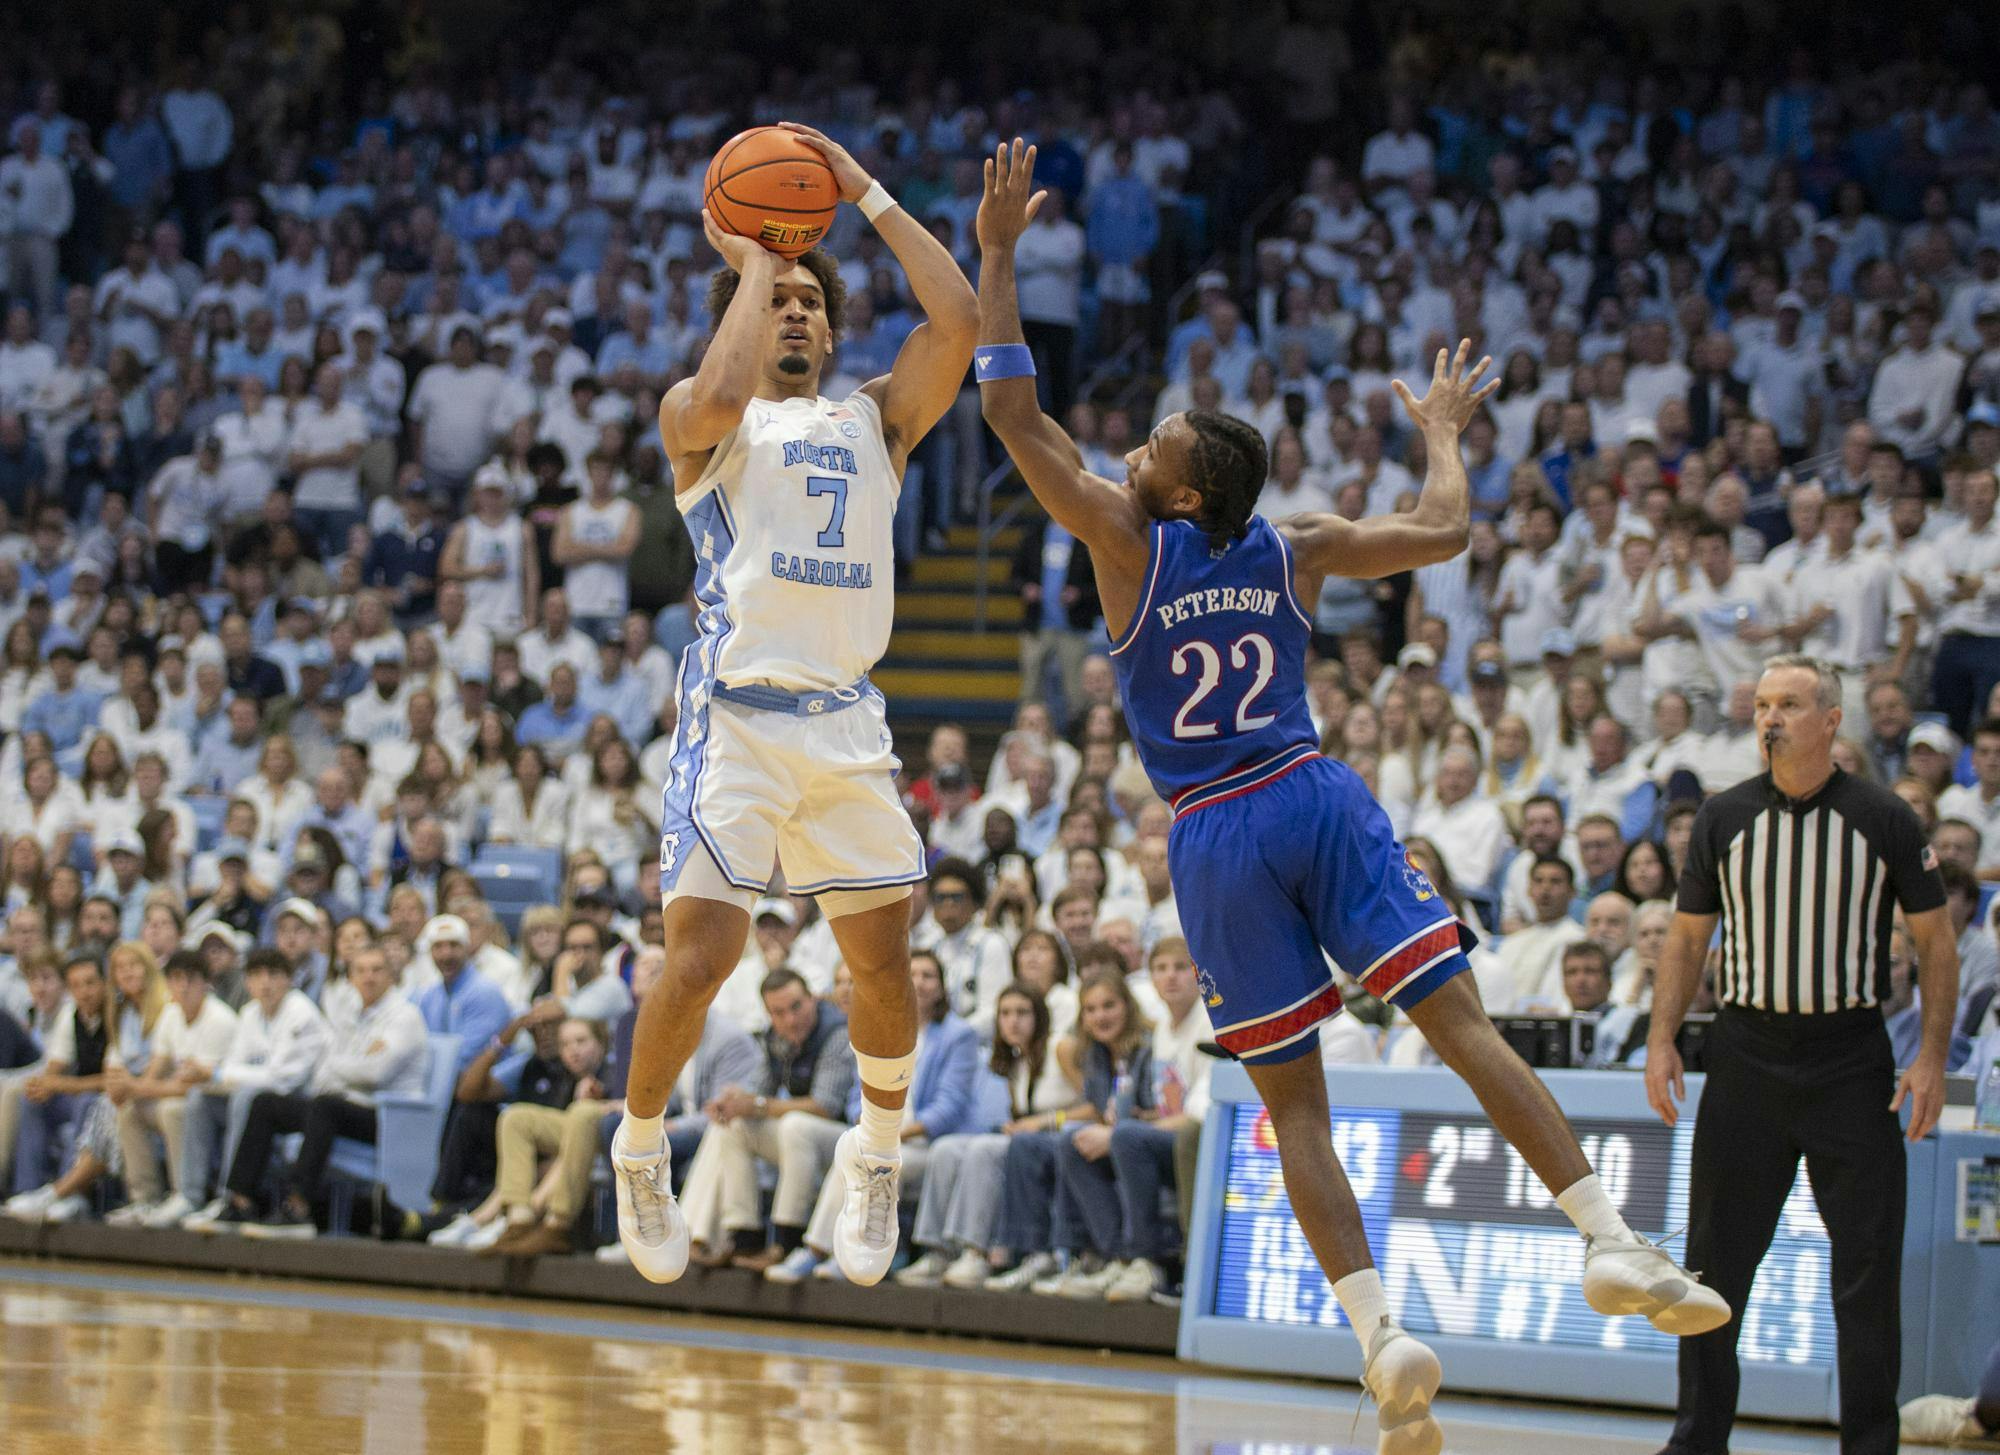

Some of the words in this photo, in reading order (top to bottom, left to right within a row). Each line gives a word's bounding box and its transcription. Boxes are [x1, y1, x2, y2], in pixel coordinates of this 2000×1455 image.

[760, 224, 824, 245] ELITE
[783, 439, 858, 475] NORTH
[807, 476, 848, 547] 7
[772, 551, 872, 589] CAROLNA
[1156, 587, 1281, 630] PETERSON
[1171, 632, 1277, 738] 22
